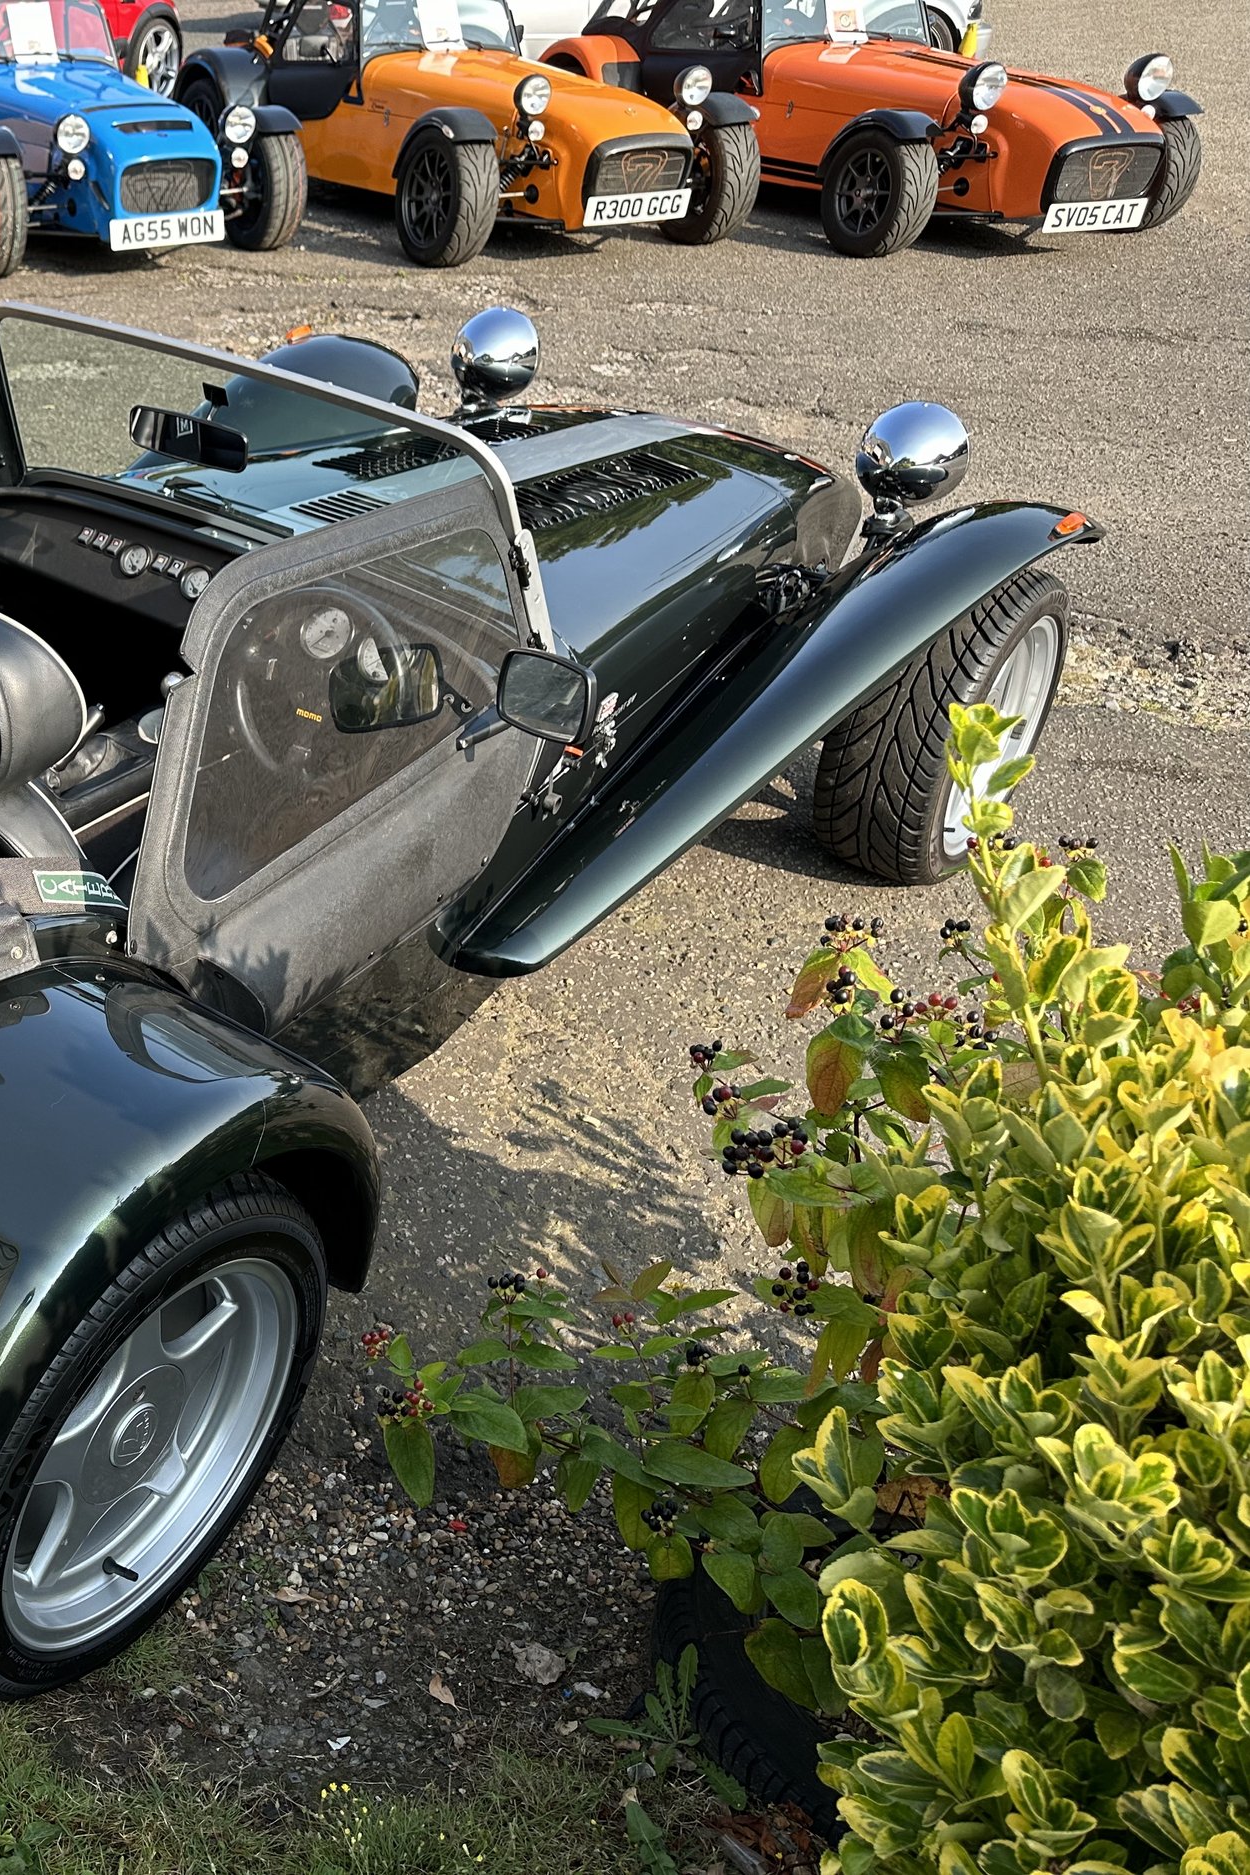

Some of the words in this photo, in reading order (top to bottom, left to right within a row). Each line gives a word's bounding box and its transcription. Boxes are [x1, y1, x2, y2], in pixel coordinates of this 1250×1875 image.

[593, 198, 643, 221] R300
[646, 194, 682, 215] GCG
[1051, 205, 1101, 228] SV05
[1102, 203, 1139, 225] CAT
[122, 219, 171, 244] AG55
[177, 215, 214, 238] WON
[296, 708, 322, 722] momo
[40, 878, 120, 900] CATER
